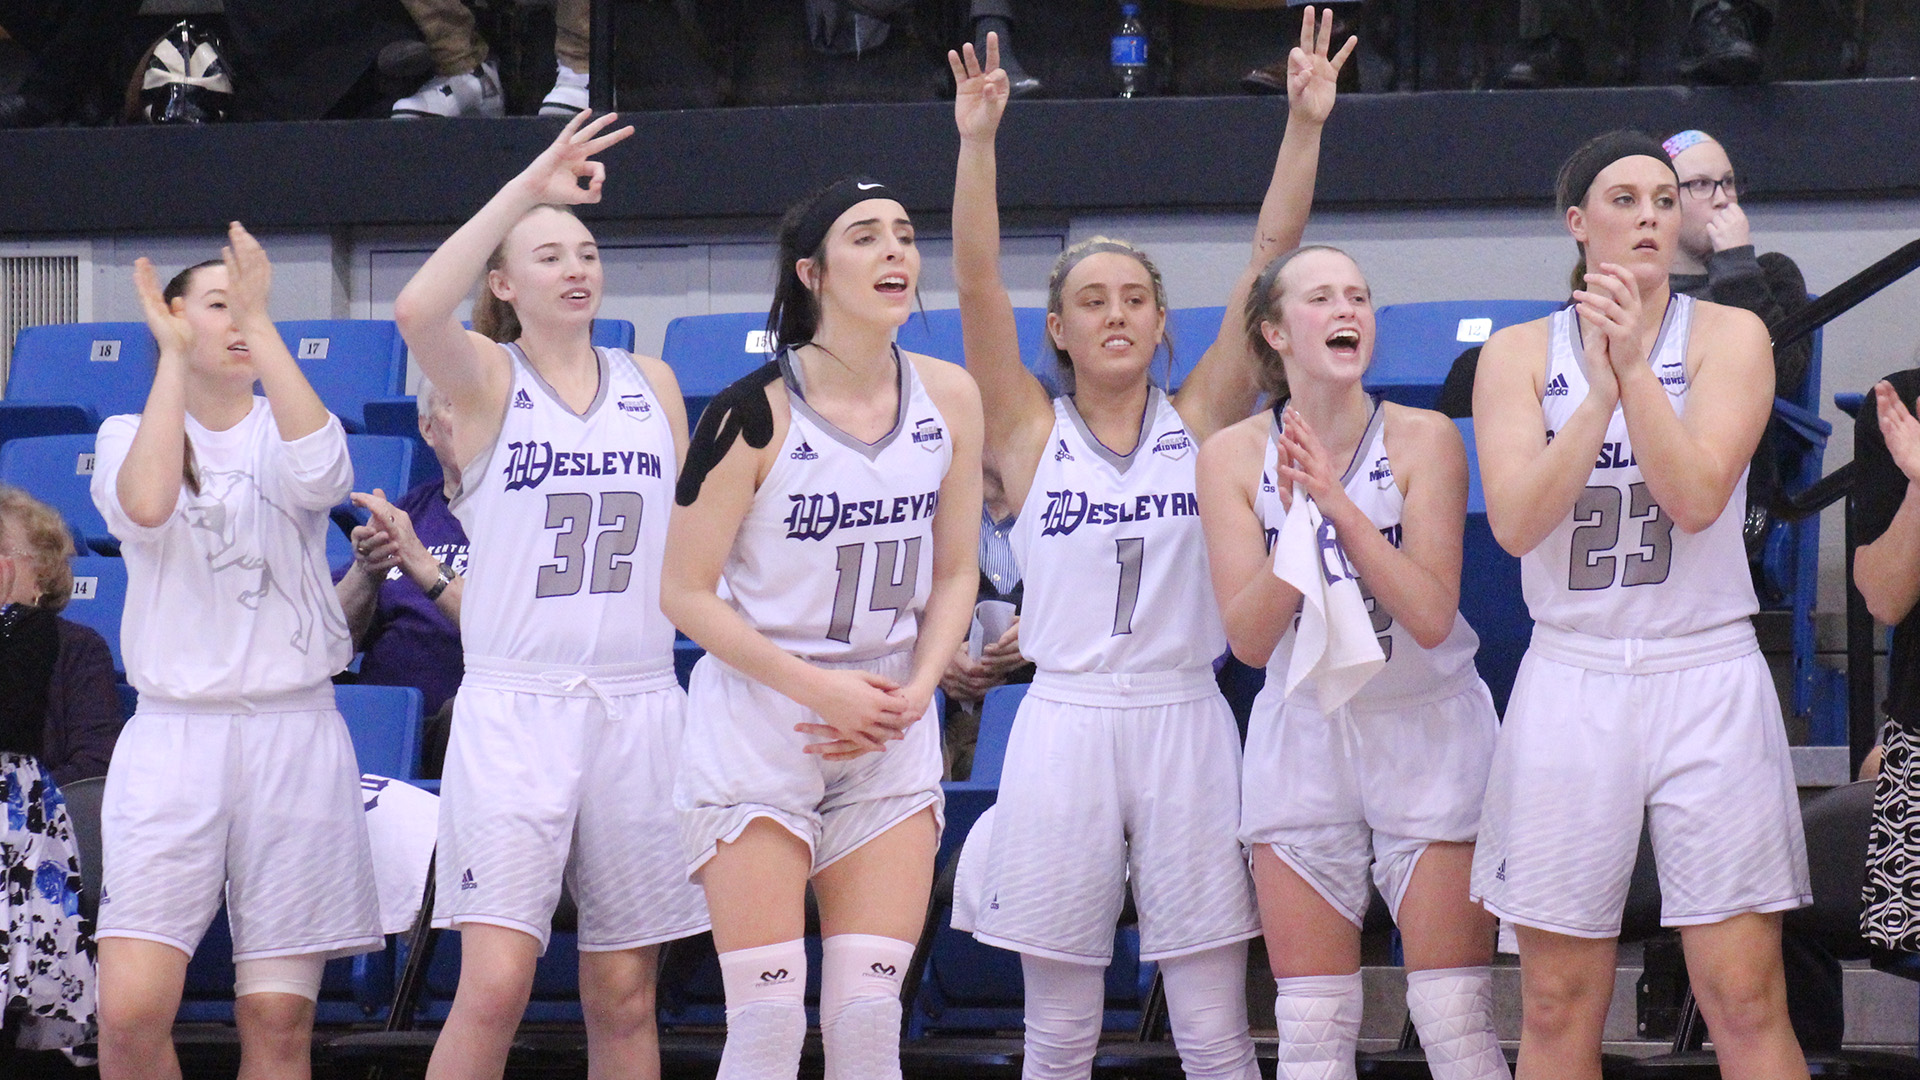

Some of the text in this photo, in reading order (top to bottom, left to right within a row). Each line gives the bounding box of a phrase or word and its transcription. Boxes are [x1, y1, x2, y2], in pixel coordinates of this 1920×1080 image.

[756, 336, 767, 347] 15
[99, 345, 112, 357] 18
[307, 343, 320, 354] 17
[1568, 482, 1674, 591] 23
[427, 544, 470, 554] KENTU
[536, 491, 643, 599] 32
[74, 582, 87, 594] 14
[826, 536, 922, 644] 14
[1111, 537, 1144, 637] 1
